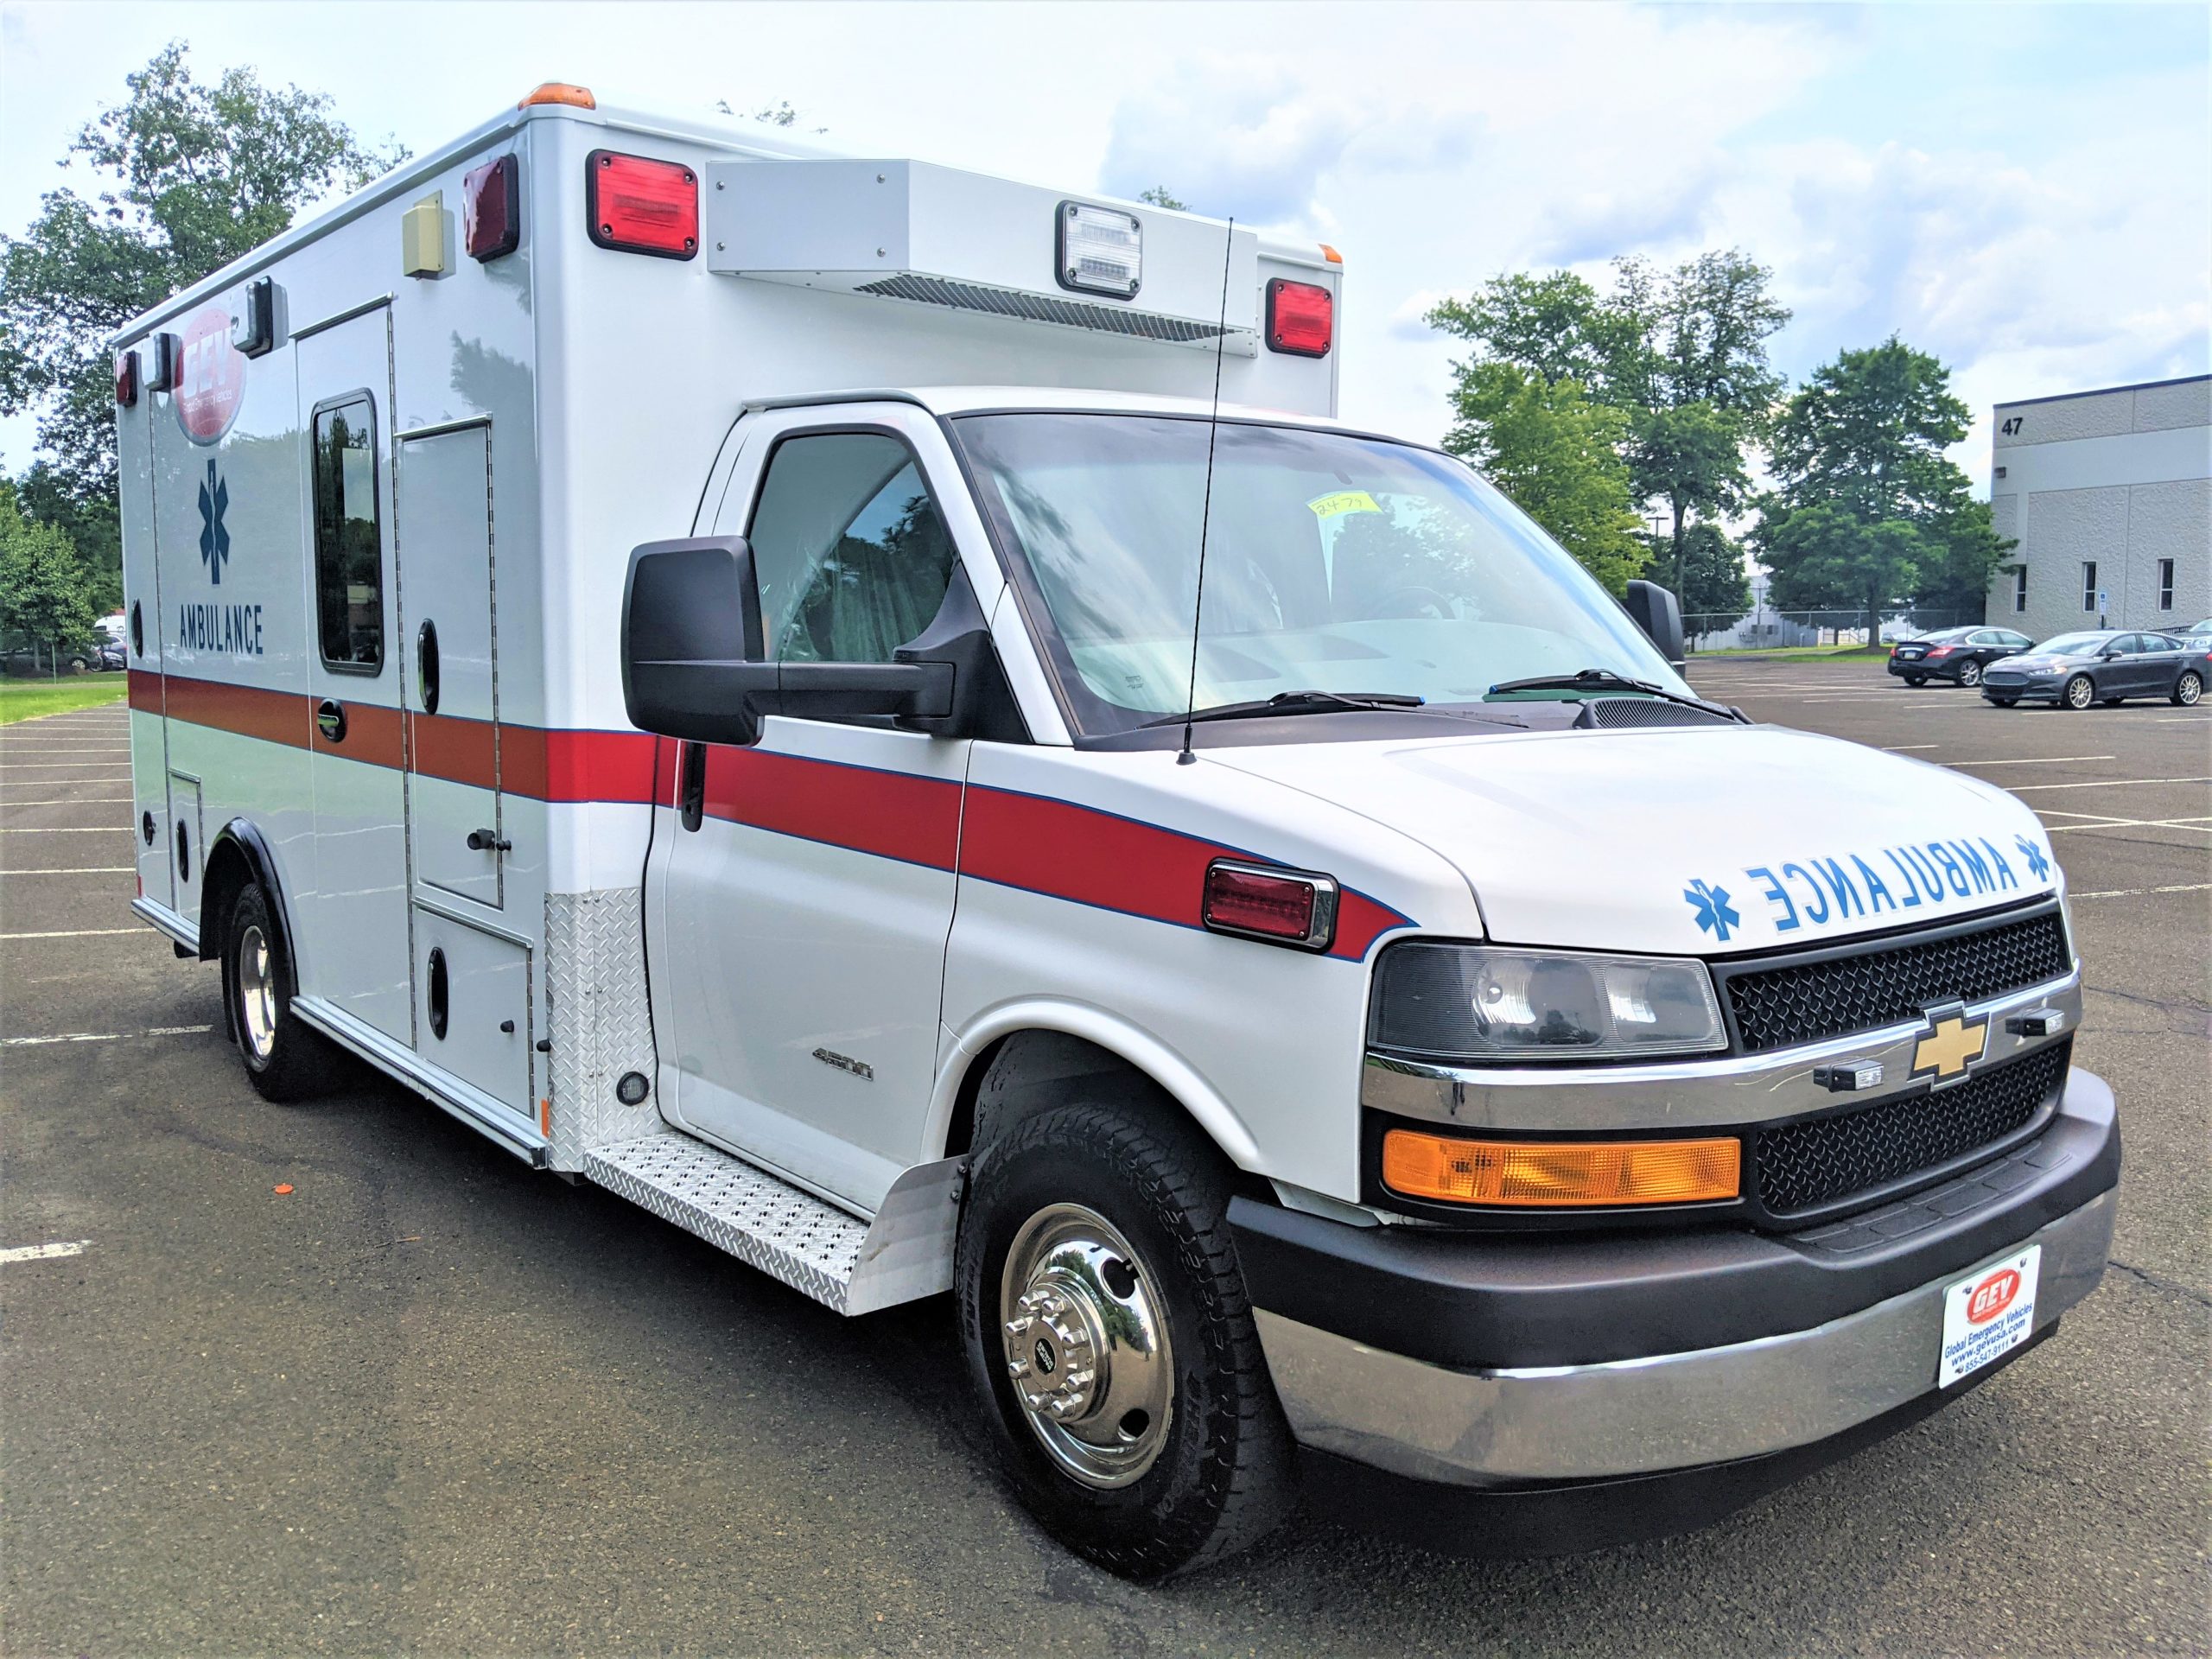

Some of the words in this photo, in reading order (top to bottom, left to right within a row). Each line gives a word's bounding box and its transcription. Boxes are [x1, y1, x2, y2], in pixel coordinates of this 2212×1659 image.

[182, 326, 232, 399] GEV
[2001, 417, 2023, 435] 47
[181, 603, 263, 654] AMBULANCE
[812, 1047, 874, 1082] 4500
[1972, 1274, 2014, 1314] GEV
[1944, 1336, 1967, 1358] Global
[1967, 1318, 2005, 1346] Emergency
[2006, 1302, 2032, 1324] Vehicles
[1951, 1319, 2025, 1366] www.gevusa.com
[1965, 1338, 2009, 1372] 855-547-9111
